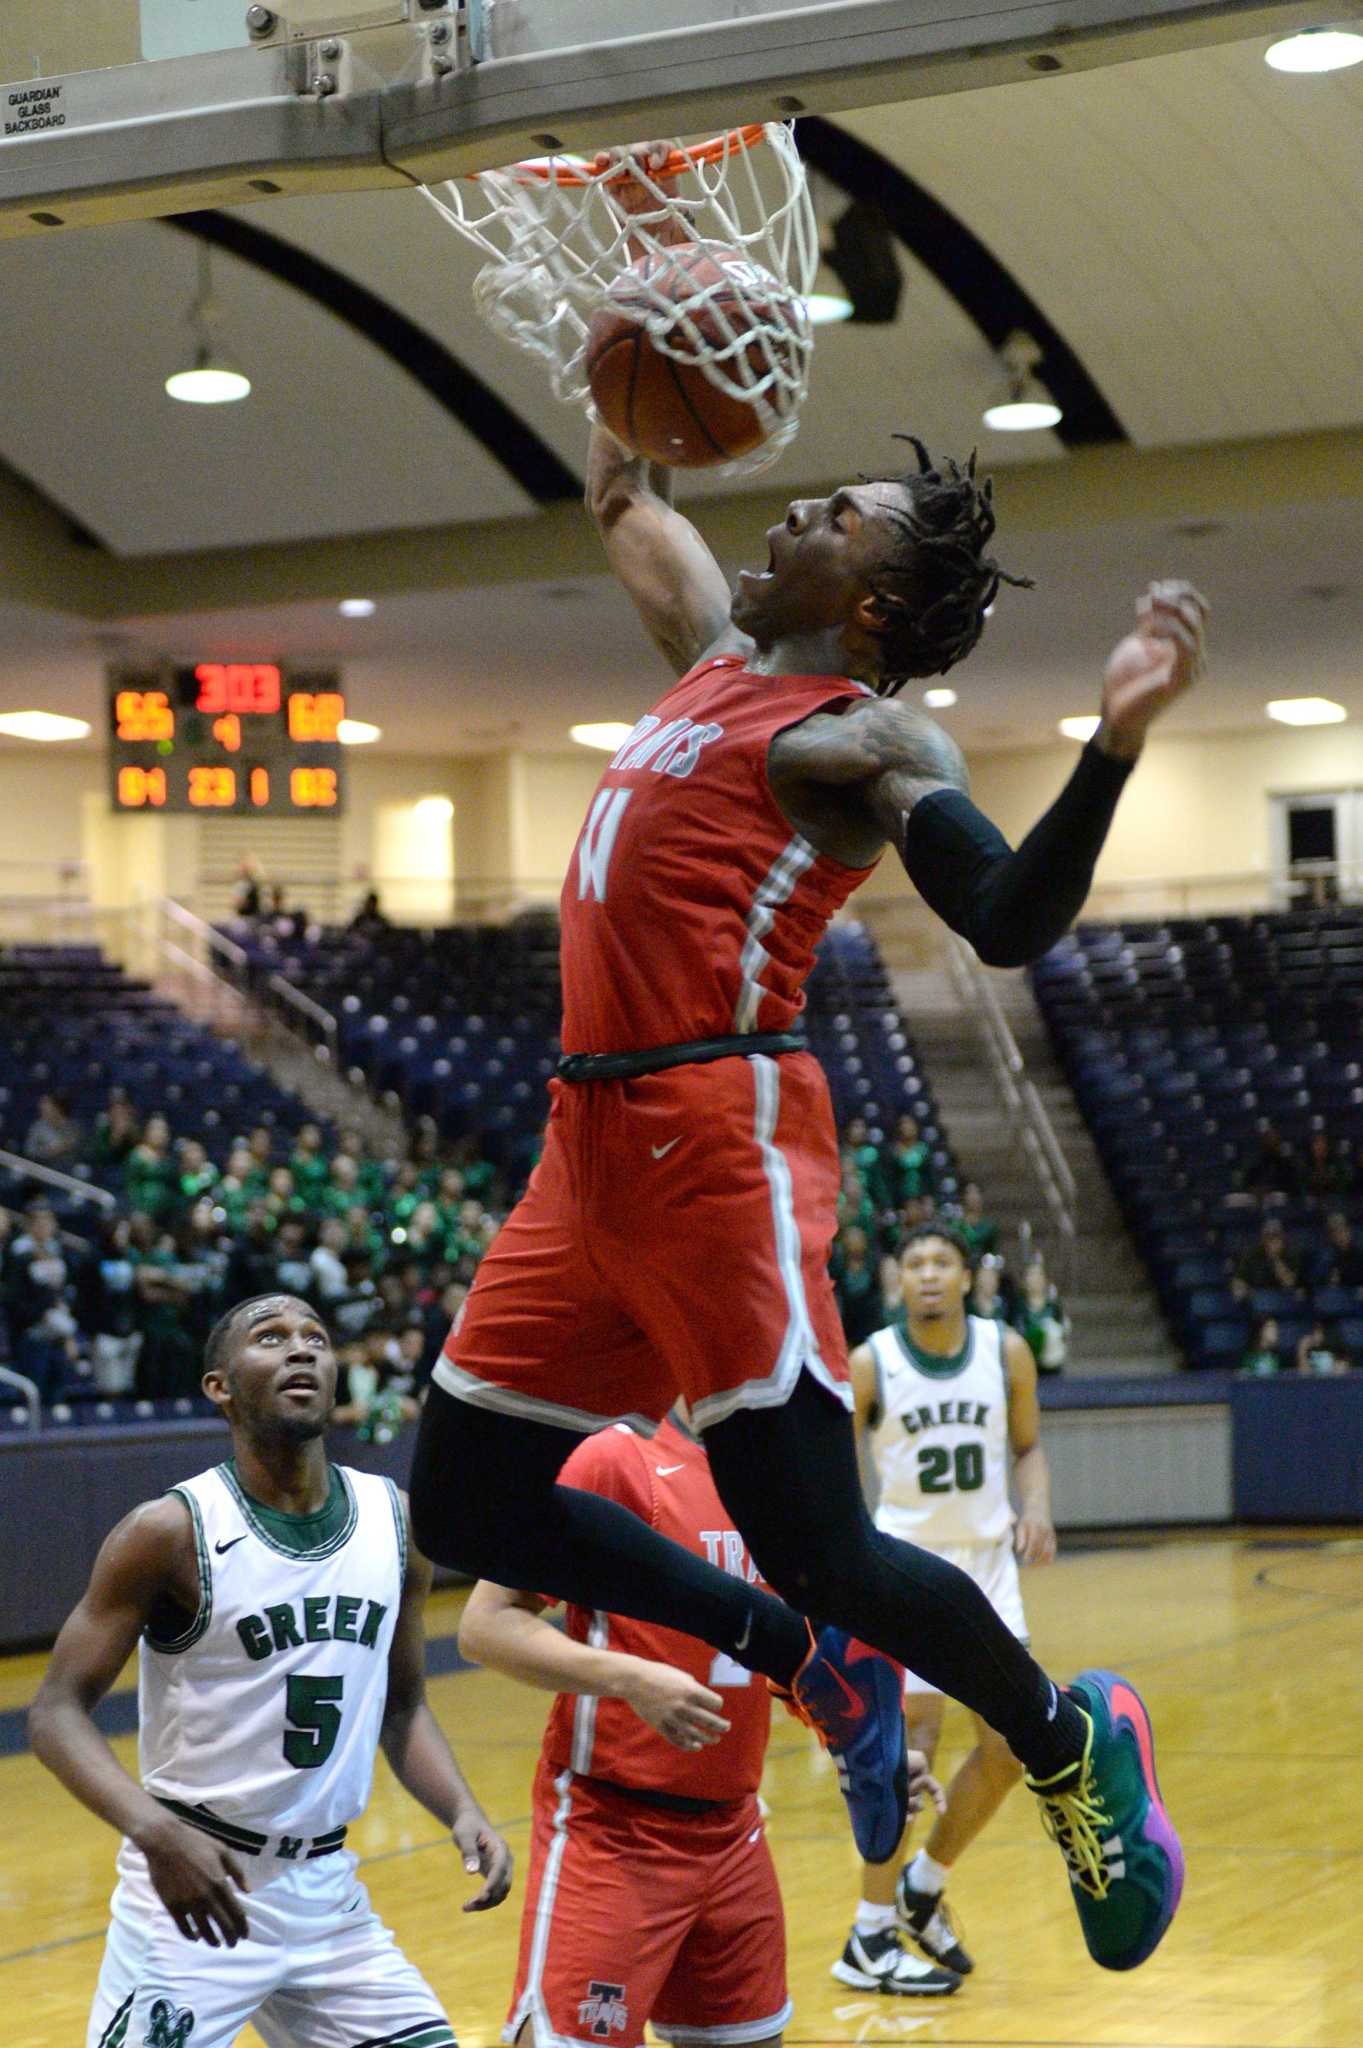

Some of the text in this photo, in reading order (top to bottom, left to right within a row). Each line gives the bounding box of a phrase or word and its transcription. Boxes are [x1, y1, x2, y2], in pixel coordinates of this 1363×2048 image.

[8, 85, 62, 106] GUARDIAN
[17, 102, 51, 118] GLASS
[4, 113, 66, 134] BACKBOARD
[901, 1401, 990, 1434] CREEK
[917, 1441, 984, 1493] 20
[236, 1595, 388, 1661] CREEK
[282, 1674, 344, 1769] 5
